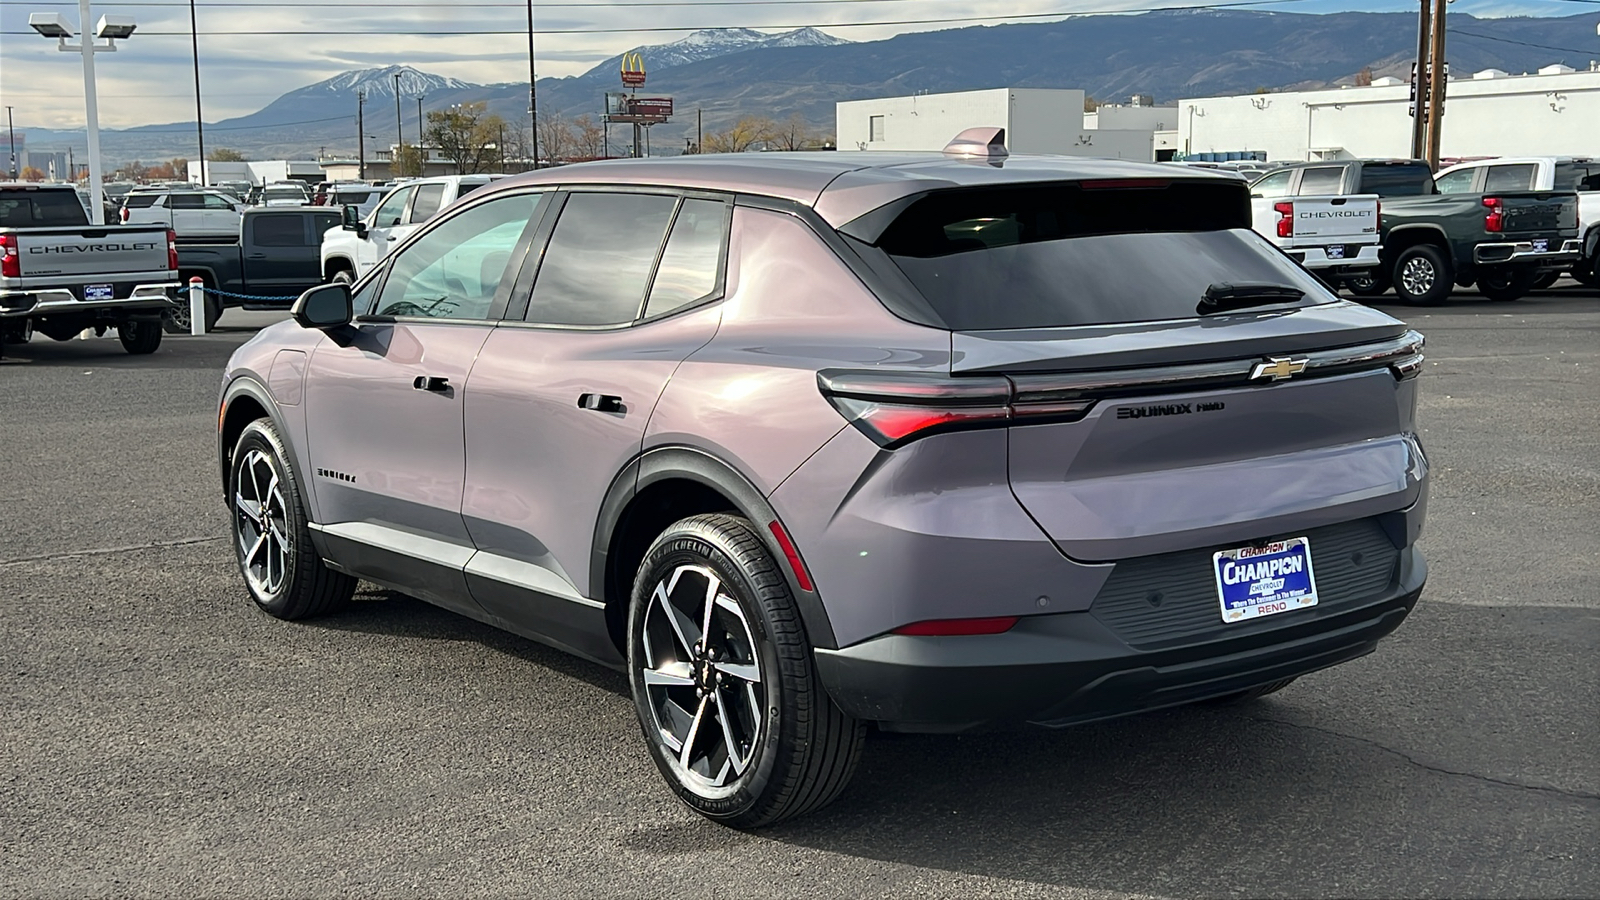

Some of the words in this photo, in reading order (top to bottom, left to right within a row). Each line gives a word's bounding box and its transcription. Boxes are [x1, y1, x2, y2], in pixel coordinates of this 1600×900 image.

[1300, 210, 1373, 219] CHEVROLET
[29, 243, 157, 255] CHEVROLET
[1117, 403, 1192, 420] EQUINOX
[663, 540, 710, 558] MICHELIN
[1240, 542, 1284, 558] CHAMPION
[1223, 555, 1302, 585] CHAMPION
[1251, 580, 1283, 593] CHEVROLET
[1258, 602, 1287, 615] RENO
